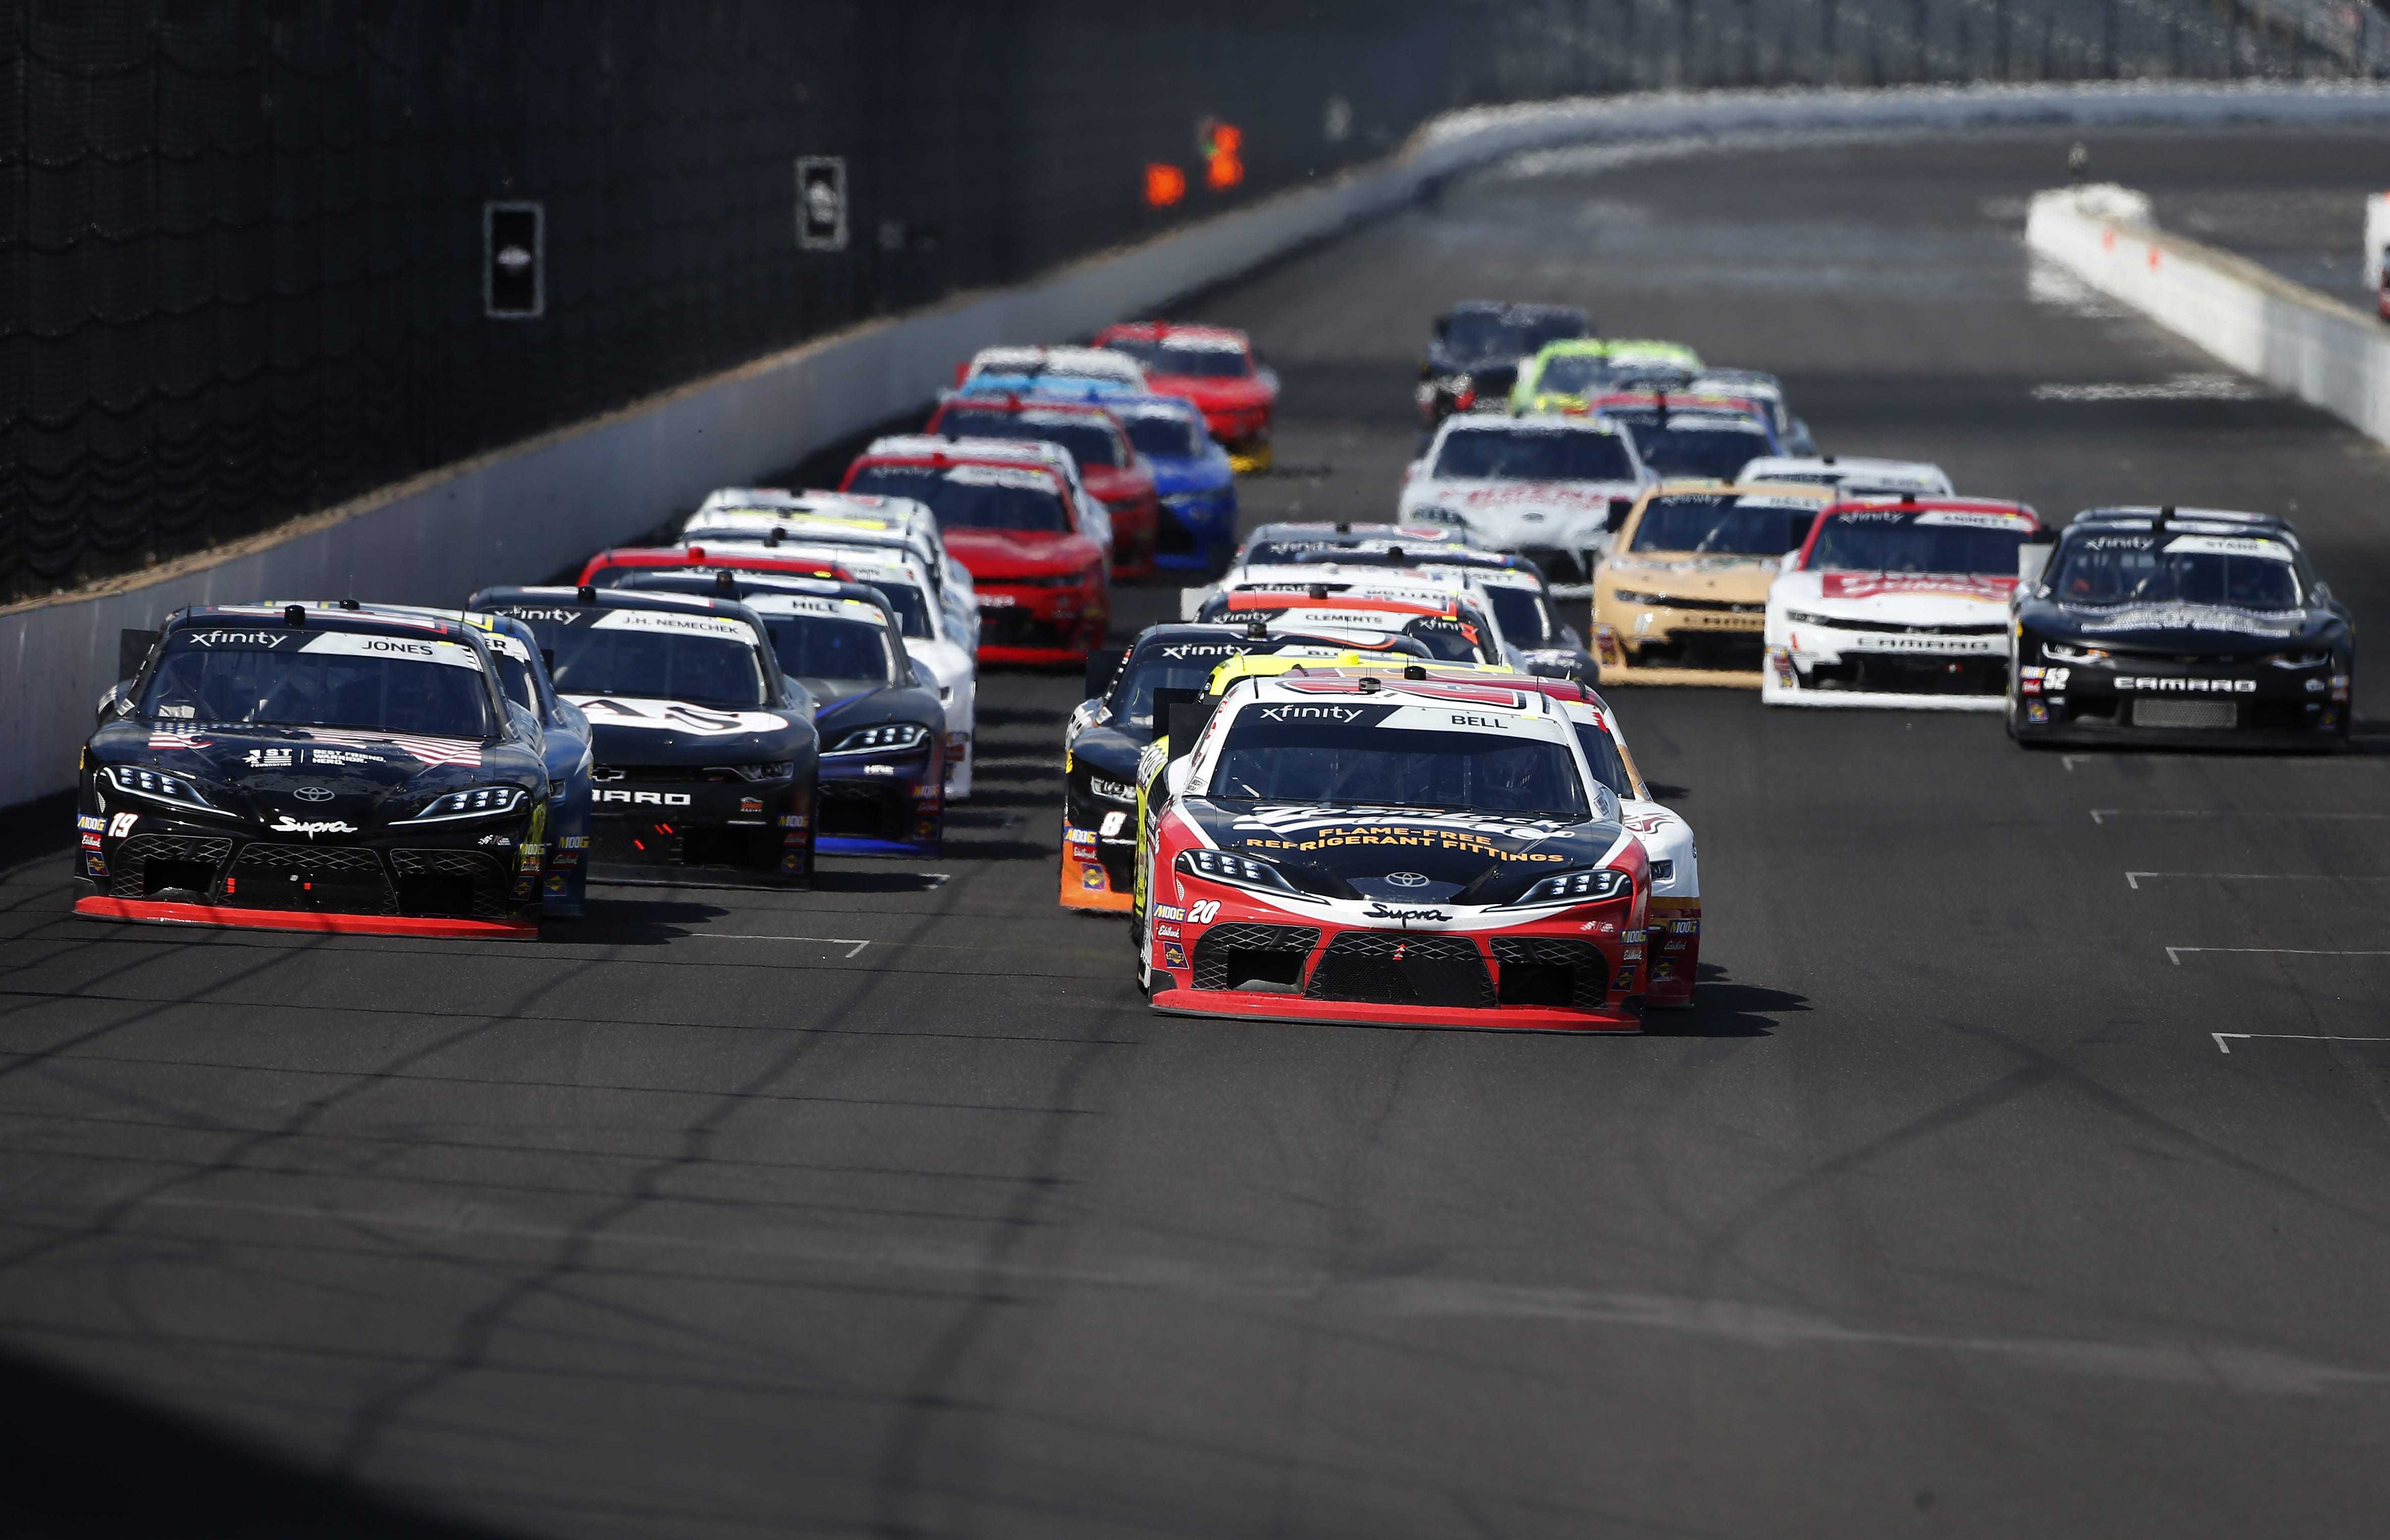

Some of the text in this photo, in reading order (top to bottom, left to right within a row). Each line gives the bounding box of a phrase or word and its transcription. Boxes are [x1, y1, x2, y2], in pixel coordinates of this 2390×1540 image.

[792, 600, 839, 613] HILL
[623, 616, 652, 626] J.H.
[657, 619, 739, 634] NEMECHEK
[1213, 611, 1383, 624] xfinity CLEMENTS
[189, 630, 433, 655] xfinity JONES
[1162, 643, 1253, 659] xfinity
[1858, 637, 1988, 651] CAMARO
[2043, 667, 2071, 690] 52
[2113, 676, 2257, 692] CAMARO
[1260, 704, 1508, 729] xfinity BELL
[313, 753, 367, 763] WARRIOR.
[345, 752, 387, 762] FRIEND.
[107, 812, 138, 838] 19
[270, 816, 358, 840] Supra
[1099, 811, 1127, 837] 8
[1319, 827, 1492, 846] FLAME-FREE
[1246, 836, 1564, 862] REFRIGERANT FITTINGS
[1154, 905, 1185, 921] MOOG
[1187, 899, 1222, 924] 20
[1362, 903, 1453, 929] Supra
[1670, 921, 1698, 933] MOOG
[1621, 930, 1647, 943] MOOG
